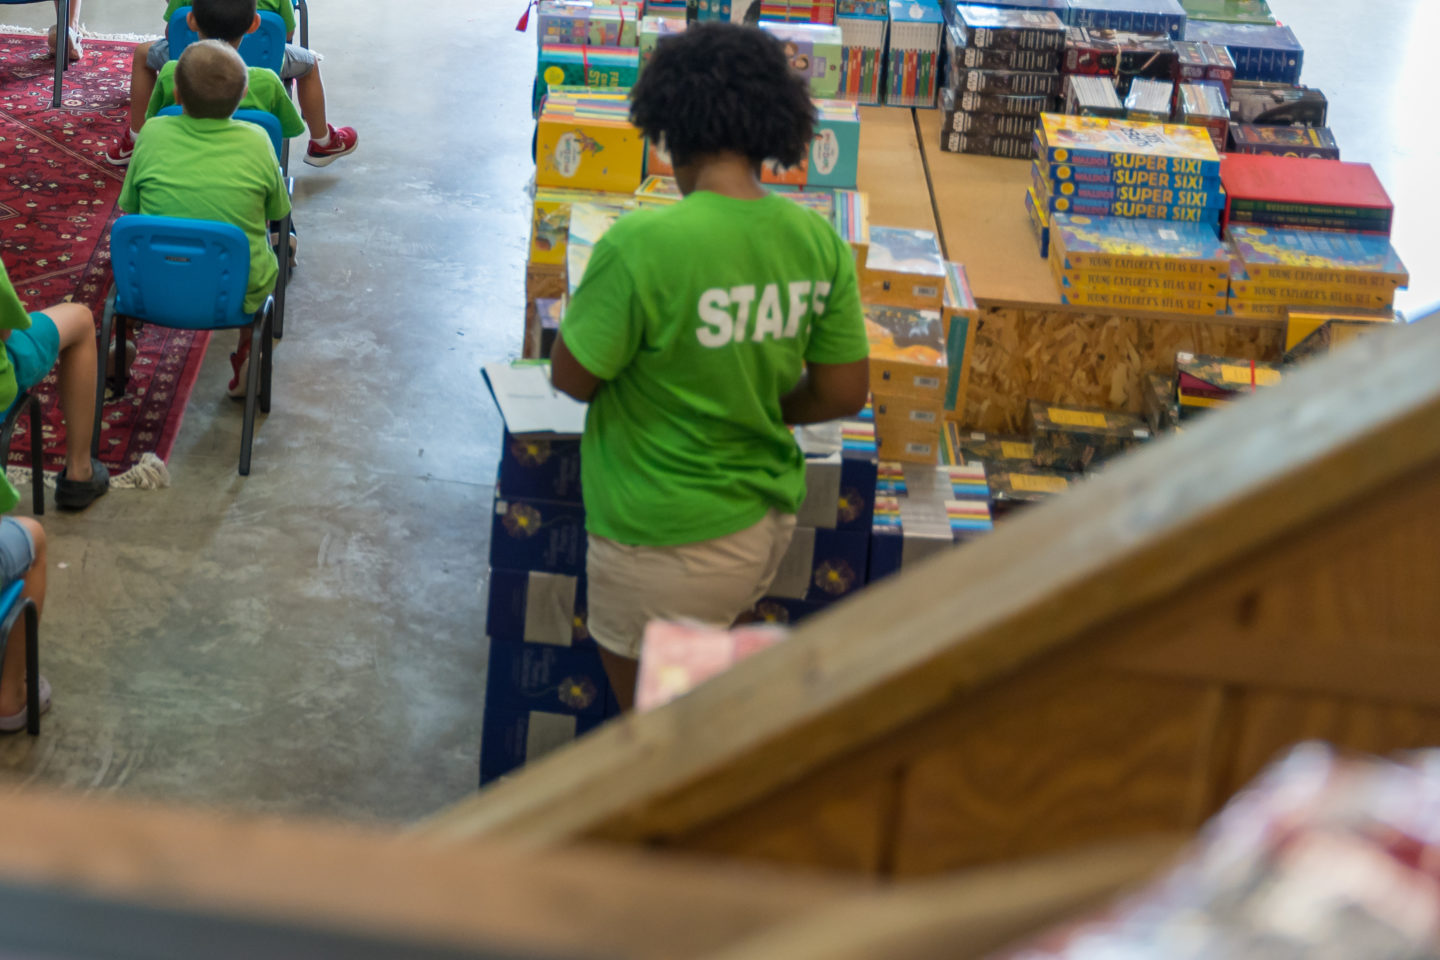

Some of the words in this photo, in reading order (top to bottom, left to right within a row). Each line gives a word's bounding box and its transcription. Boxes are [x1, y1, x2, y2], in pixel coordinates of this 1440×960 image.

[1113, 153, 1167, 171] SUPER
[1172, 159, 1202, 174] SIX!
[1116, 170, 1169, 187] SUPER
[1174, 175, 1203, 190] SIX!
[1120, 187, 1173, 203] SUPER
[1178, 192, 1207, 207] SIX!
[1115, 203, 1167, 220] SUPER
[1172, 207, 1201, 222] SIX!
[1089, 257, 1111, 267] YOUNG
[1114, 258, 1160, 270] EXPLORER'S
[1164, 262, 1186, 272] ATLAS
[1190, 264, 1204, 273] SET
[1088, 274, 1110, 285] YOUNG
[1113, 276, 1159, 288] EXPLORER'S
[1163, 280, 1185, 290] ATLAS
[1188, 281, 1202, 291] SET
[1268, 269, 1290, 279] YOUNG
[1294, 270, 1341, 283] EXPLORER'S
[1345, 273, 1367, 285] ATLAS
[1371, 275, 1385, 286] SET
[1087, 293, 1109, 304] YOUNG
[1112, 295, 1158, 307] EXPLORER'S
[1162, 297, 1184, 308] ATLAS
[1187, 299, 1201, 309] SET
[1254, 286, 1276, 296] YOUNG
[1280, 288, 1326, 300] EXPLORER'S
[1330, 291, 1352, 303] ATLAS
[1356, 293, 1370, 304] SET
[695, 280, 832, 349] STAFF
